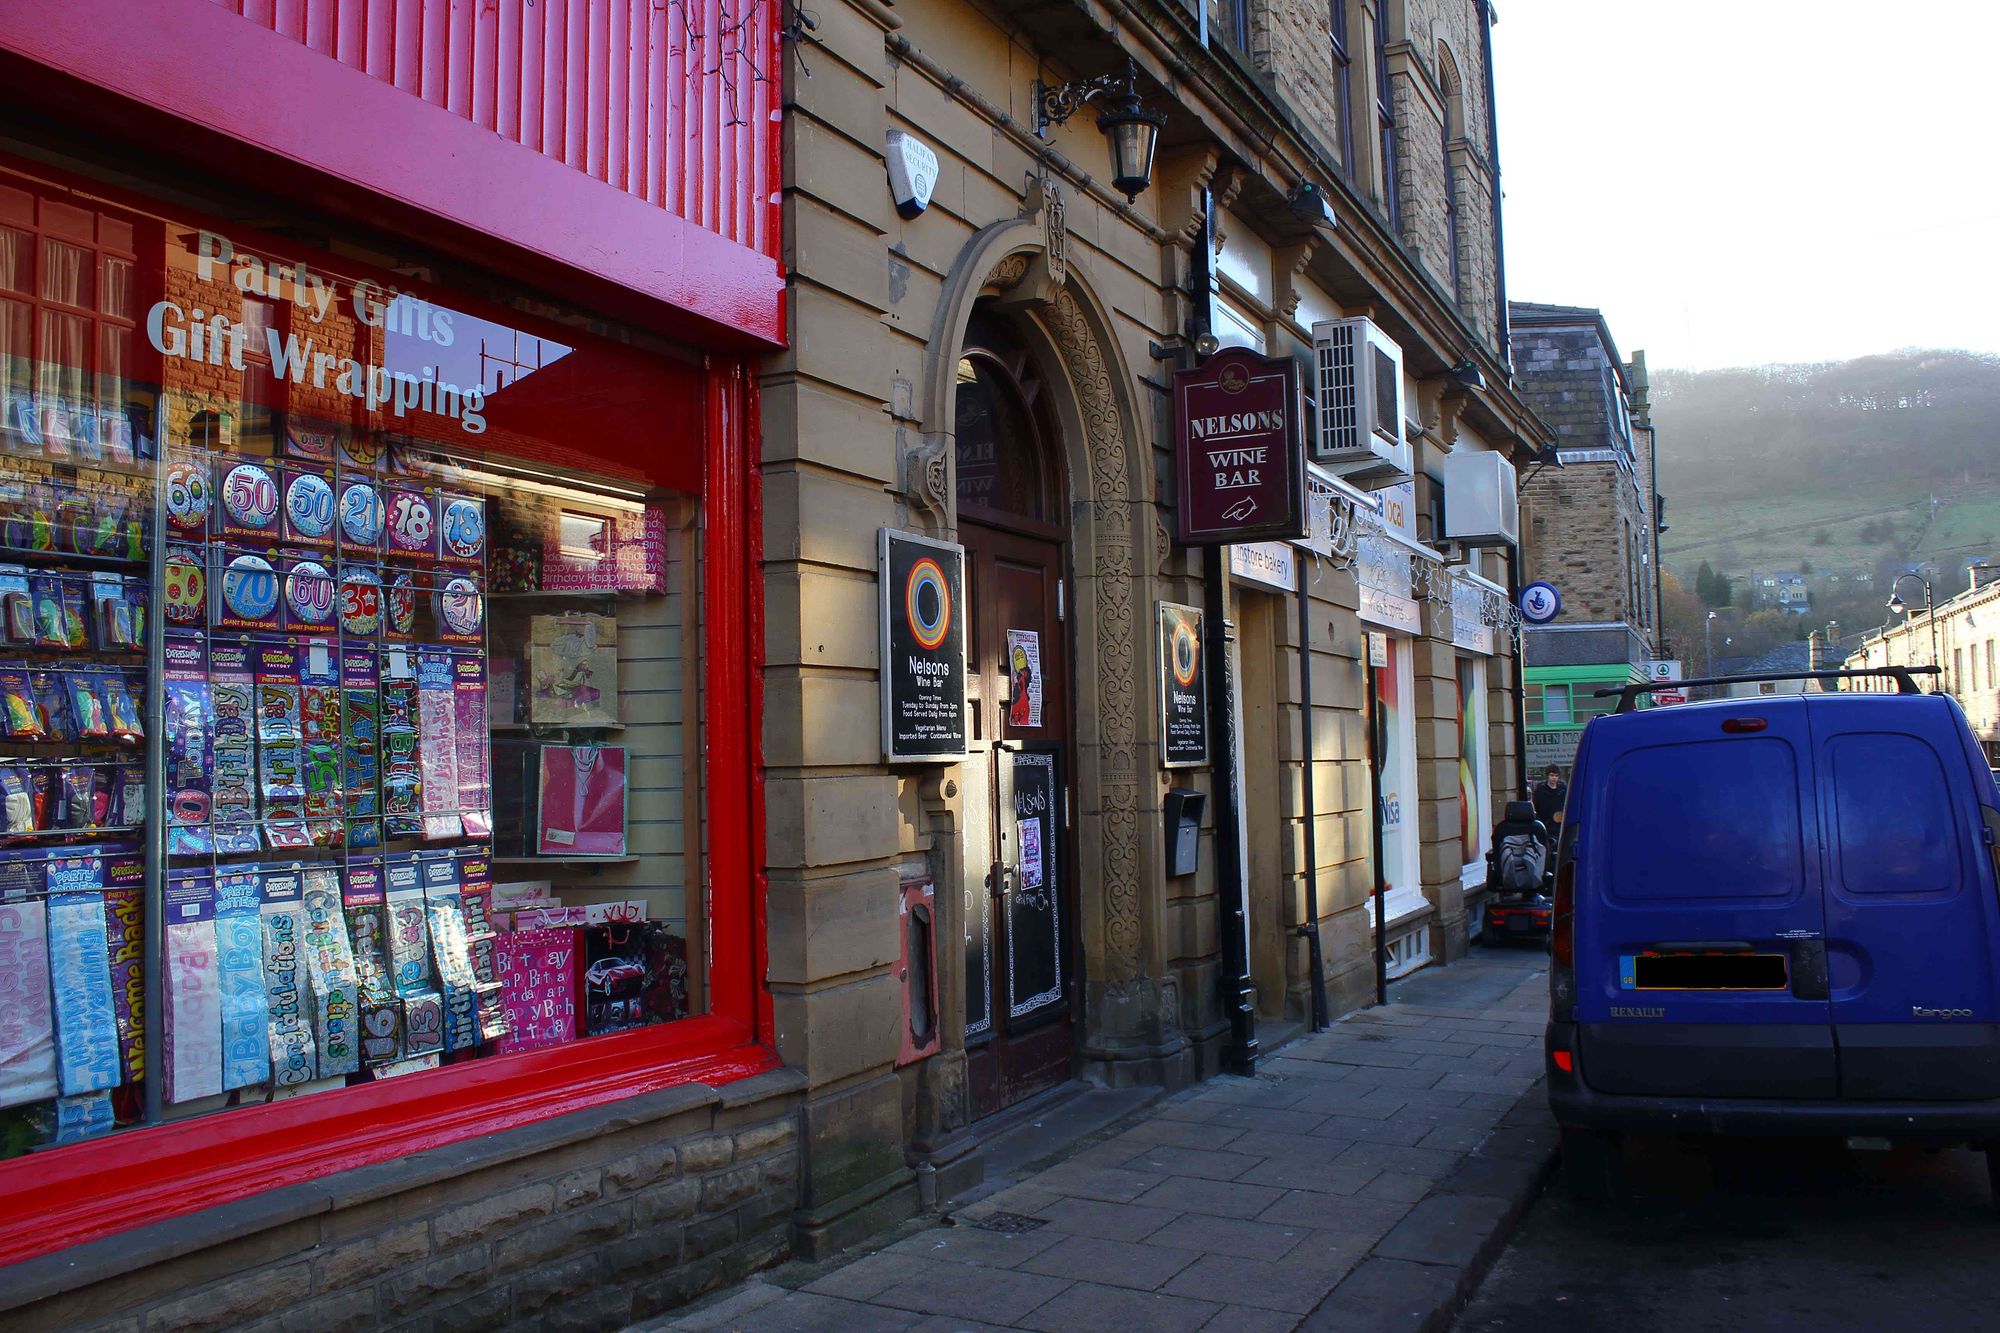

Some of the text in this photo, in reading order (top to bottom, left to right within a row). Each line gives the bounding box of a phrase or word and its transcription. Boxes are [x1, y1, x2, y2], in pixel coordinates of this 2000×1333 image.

[906, 152, 936, 179] SECURITY
[197, 230, 455, 347] Party Gifts
[147, 301, 488, 434] Gift Wrapping
[1191, 408, 1284, 440] NELSONS
[1209, 449, 1267, 468] WINE
[231, 472, 277, 515] 50
[1215, 469, 1261, 488] BAR
[293, 480, 334, 524] 50
[345, 488, 377, 531] 21
[395, 498, 431, 541] 18
[447, 503, 481, 545] 18
[587, 573, 624, 584] Happy
[1235, 545, 1288, 580] instore bakery
[232, 562, 274, 606] 70
[293, 567, 331, 610] 60
[909, 655, 950, 676] Nelsons
[916, 675, 944, 688] Wine Bar
[902, 701, 918, 710] Tuesday
[925, 702, 939, 711] Sunday
[902, 710, 913, 718] Food
[913, 710, 928, 718] Served
[1173, 690, 1196, 705] Nelsons
[915, 724, 936, 732] Vegetarian
[308, 742, 340, 792] 50
[167, 788, 212, 854] 70
[55, 868, 94, 884] PARTY
[220, 884, 254, 899] PARTY
[116, 897, 145, 964] Back
[224, 915, 262, 1062] Baby Boy
[1623, 976, 1634, 984] GB
[267, 914, 312, 1086] Congratulations
[1609, 1006, 1665, 1018] RENAULT
[1912, 1005, 1973, 1019] Kangoo
[363, 1008, 397, 1058] 16
[408, 1000, 440, 1051] 13
